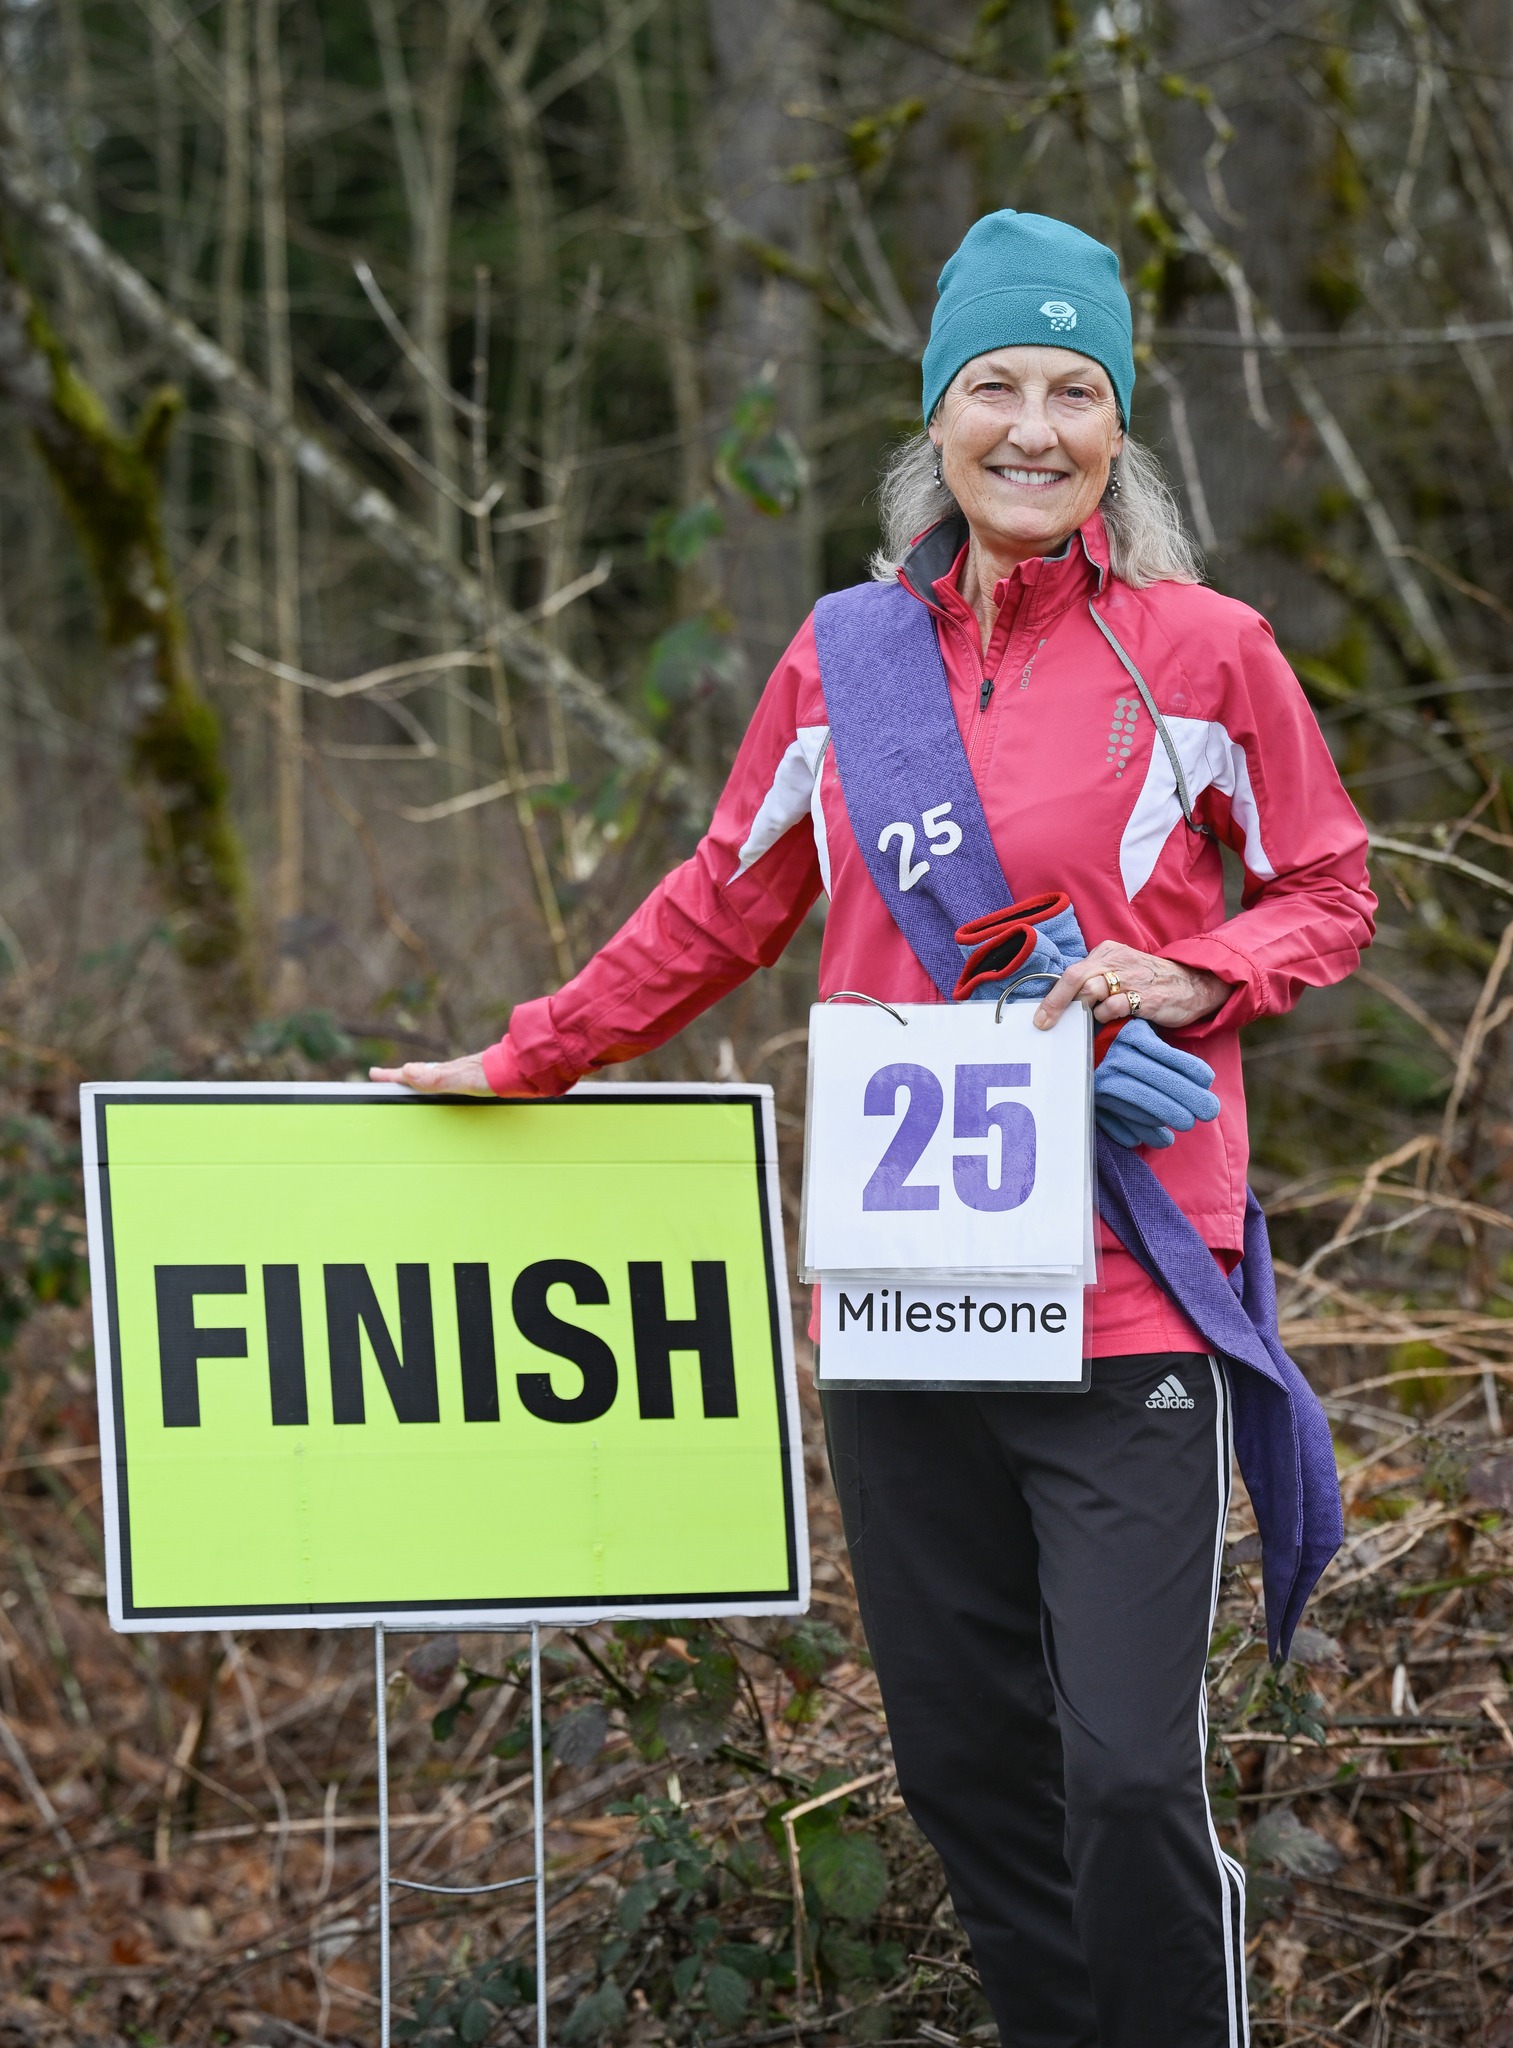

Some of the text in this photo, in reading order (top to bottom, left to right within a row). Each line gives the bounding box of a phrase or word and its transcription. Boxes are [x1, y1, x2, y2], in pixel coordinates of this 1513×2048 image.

[877, 801, 963, 892] 25
[862, 1062, 1037, 1213] 25
[153, 1258, 739, 1428] FINISH
[838, 1289, 1068, 1334] Milestone
[1145, 1396, 1195, 1410] adidas
